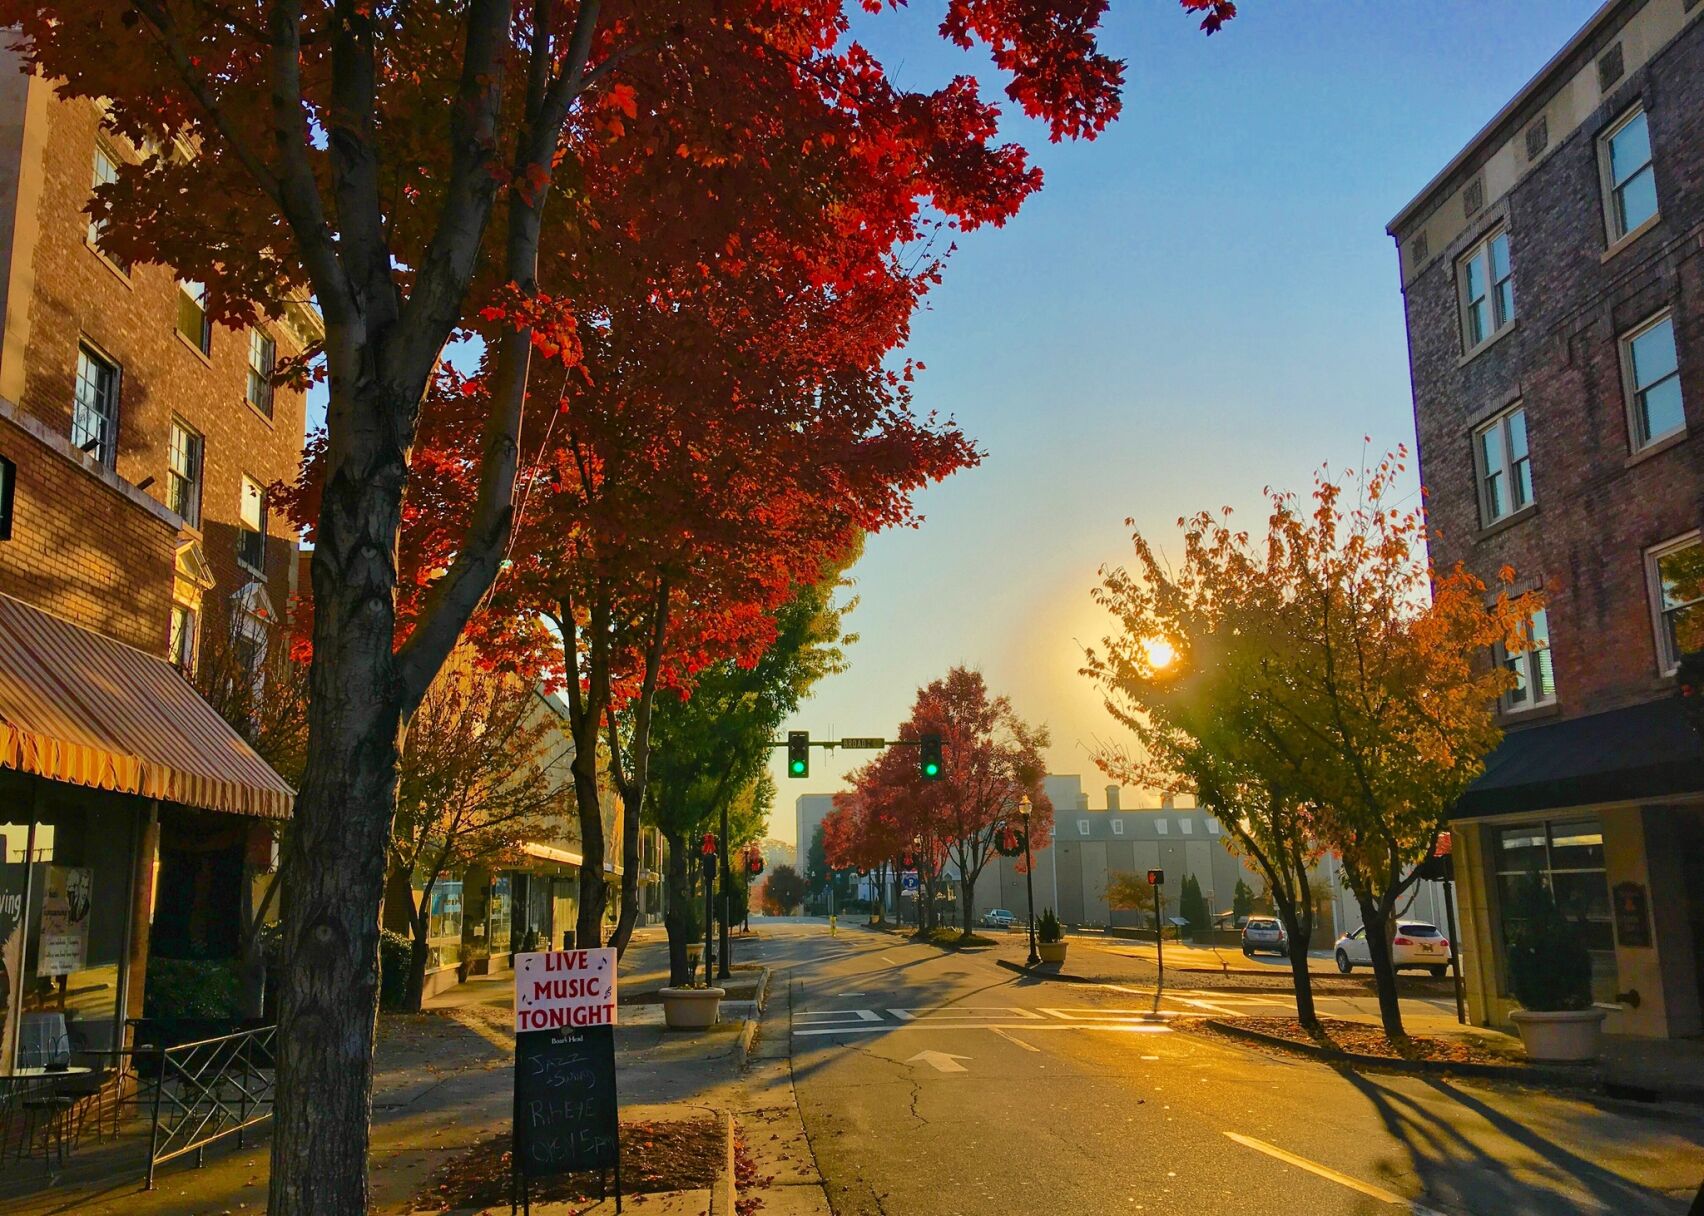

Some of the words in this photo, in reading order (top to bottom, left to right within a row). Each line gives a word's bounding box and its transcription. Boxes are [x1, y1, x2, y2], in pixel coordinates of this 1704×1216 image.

[545, 951, 588, 972] LIVE
[534, 977, 599, 1000] MUSIC
[518, 1004, 615, 1029] TONIGHT
